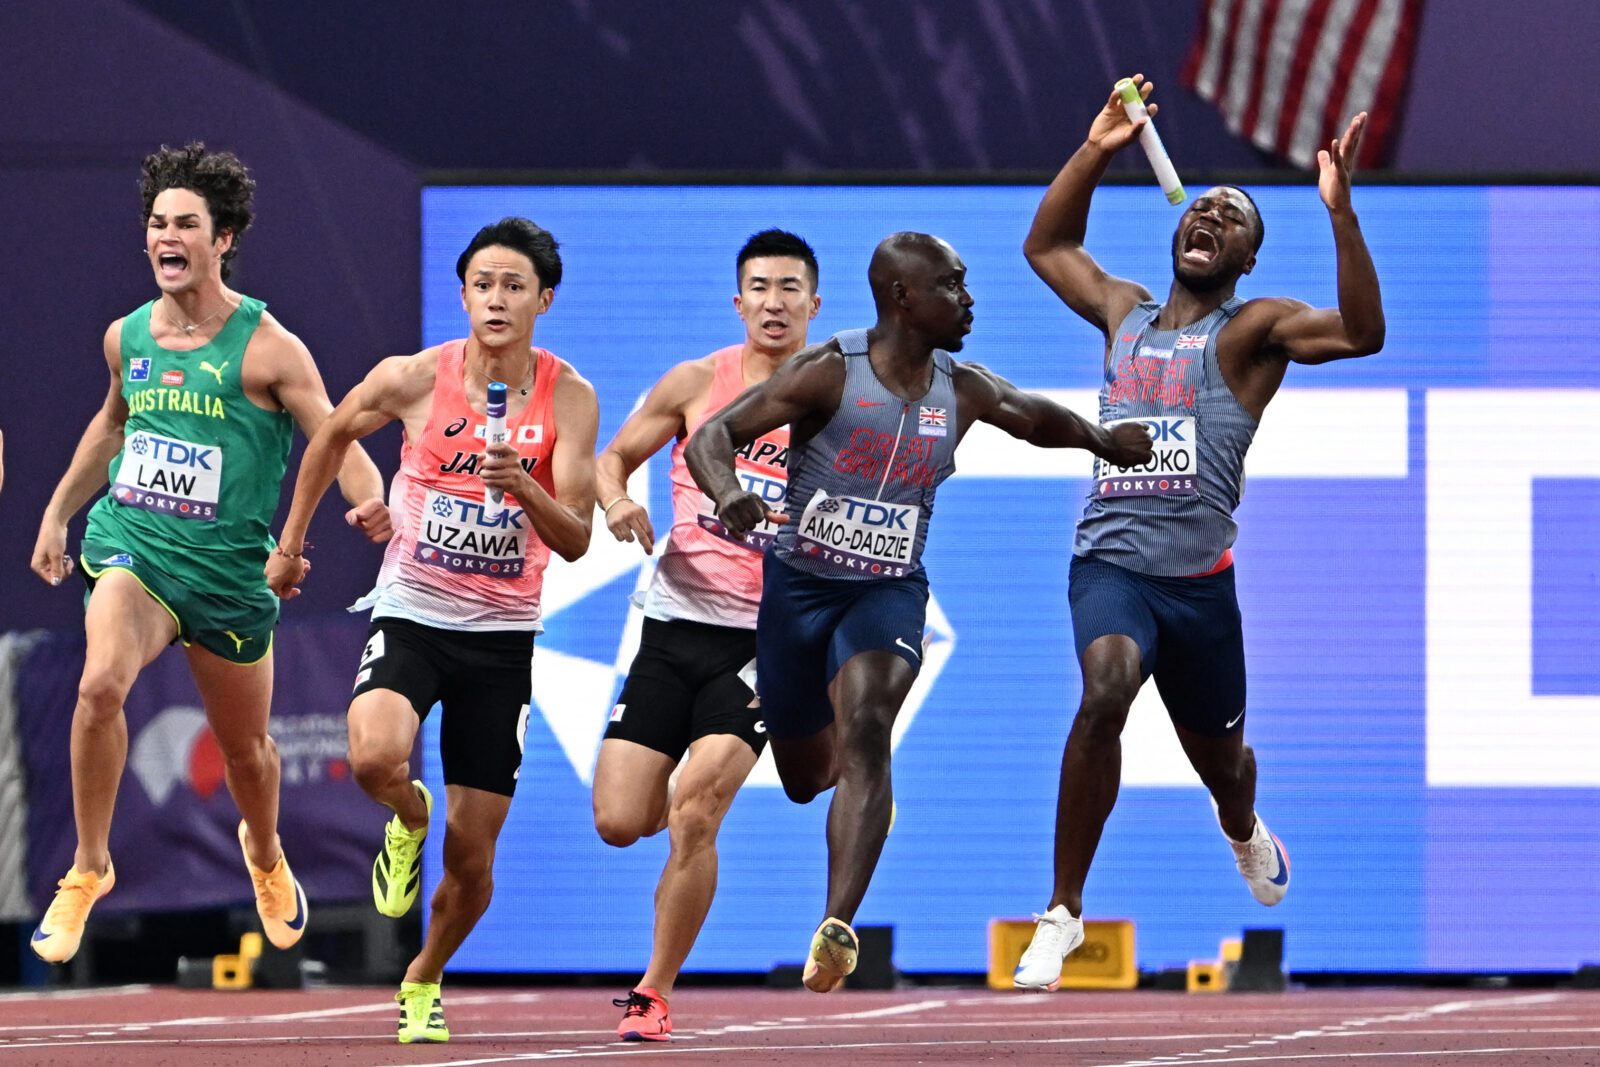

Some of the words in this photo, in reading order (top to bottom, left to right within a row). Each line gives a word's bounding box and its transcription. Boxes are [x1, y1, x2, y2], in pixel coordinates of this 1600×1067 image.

[1117, 355, 1193, 383] GREAT
[128, 388, 225, 420] AUSTRALIA
[1108, 379, 1195, 408] BRITAIN
[850, 427, 938, 461] GREAT
[1141, 420, 1187, 441] DK
[149, 436, 213, 471] TDK
[440, 452, 538, 476] JAN
[735, 440, 790, 468] APA
[833, 449, 936, 488] BRITAIN
[136, 464, 197, 496] LAW
[741, 473, 788, 503] TD
[841, 498, 911, 531] TDK
[426, 520, 519, 557] UZAWA
[804, 516, 910, 560] AMO-DADZIE
